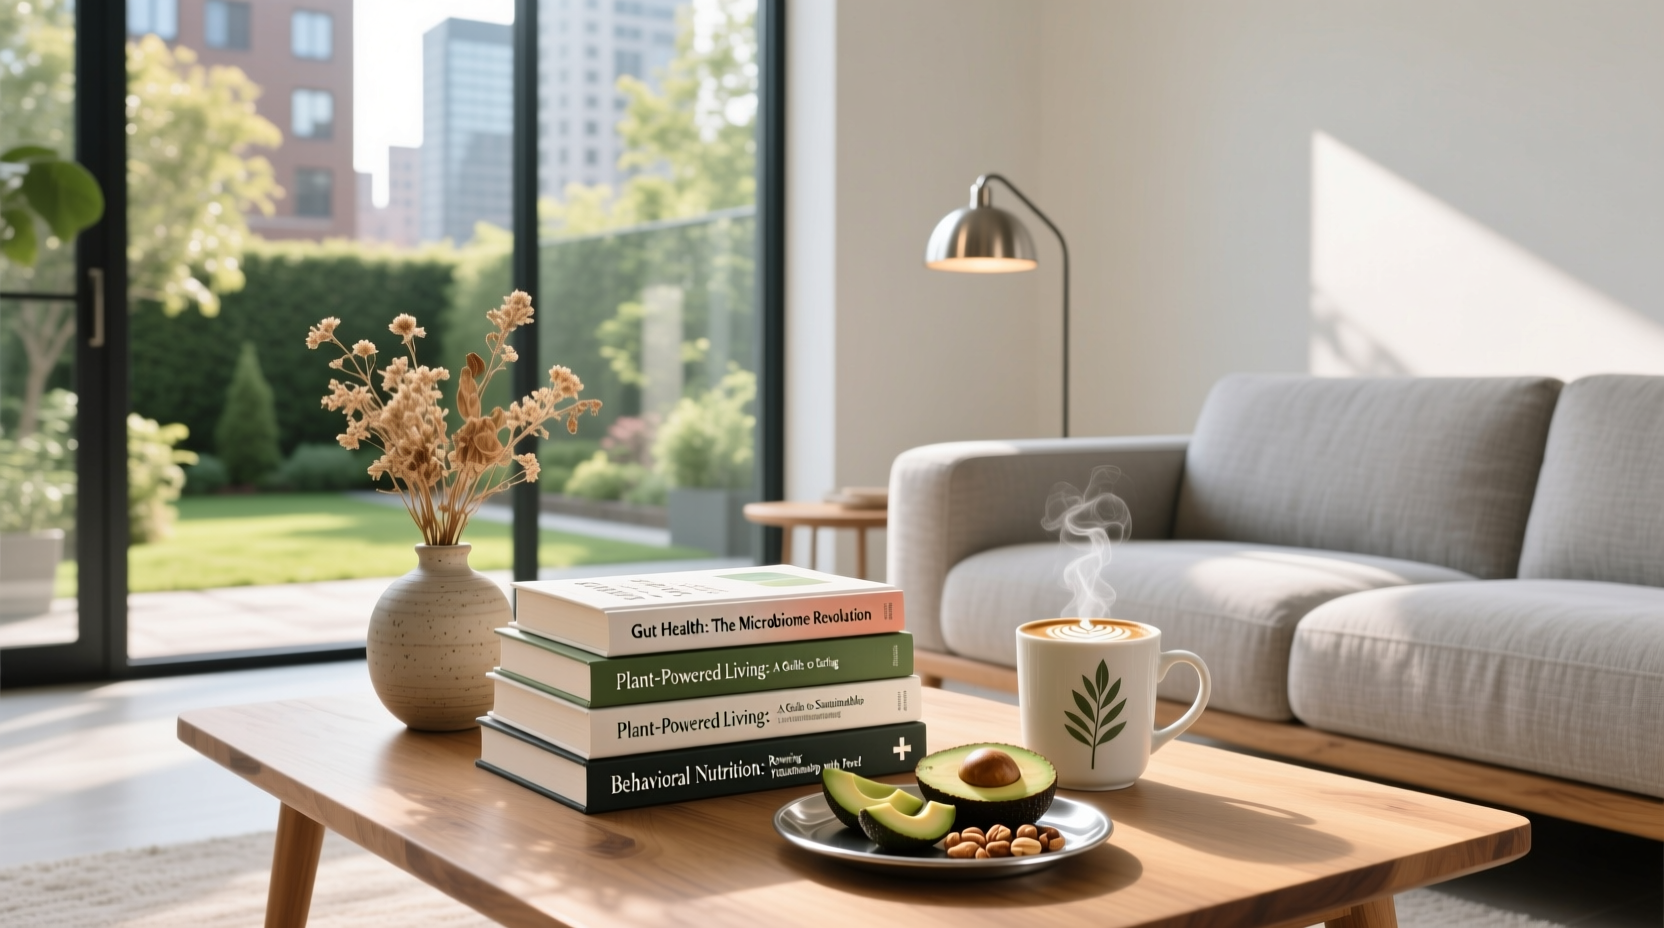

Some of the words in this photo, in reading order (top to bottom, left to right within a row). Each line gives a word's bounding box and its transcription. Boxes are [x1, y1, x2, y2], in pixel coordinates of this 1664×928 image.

[631, 623, 658, 639] Gut
[661, 618, 709, 637] Health:
[711, 617, 736, 633] The
[739, 612, 811, 631] Microbiome
[813, 608, 872, 625] Revolution
[616, 663, 722, 690] Plant-Powered
[725, 661, 770, 680] Living:
[617, 712, 720, 739] Plant-Powered
[723, 709, 770, 728] Living:
[610, 765, 690, 794] Behavioral
[695, 759, 765, 784] Nutrition:
